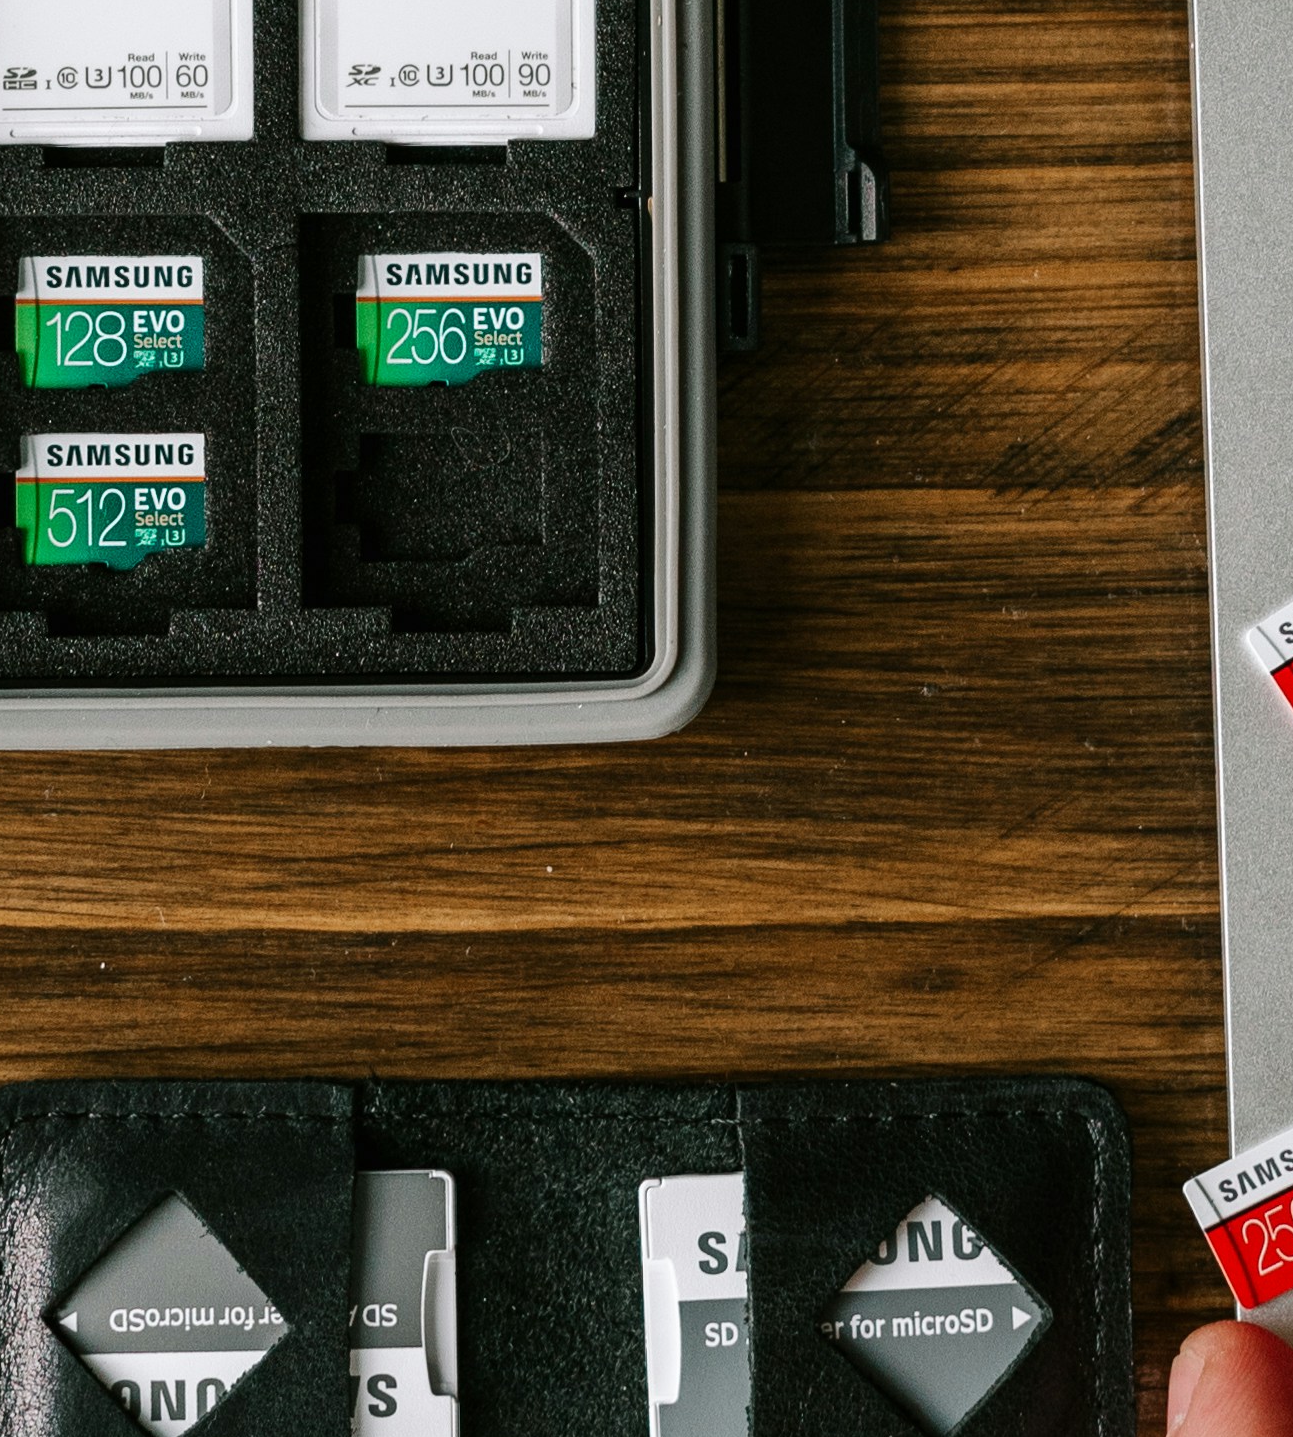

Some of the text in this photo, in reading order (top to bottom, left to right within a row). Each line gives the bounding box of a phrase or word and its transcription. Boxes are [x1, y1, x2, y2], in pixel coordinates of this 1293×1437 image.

[127, 52, 207, 63] Read Write
[470, 51, 549, 61] Read Write
[117, 64, 209, 89] 100 60
[459, 62, 551, 87] 100 90
[46, 265, 193, 289] SAMSUNG
[385, 262, 533, 287] SAMSUNG
[46, 309, 186, 368] 128 EVO
[133, 333, 183, 349] Select
[386, 306, 525, 365] 256 EVO
[473, 330, 523, 346] Select
[46, 443, 194, 468] SAMSUNG
[47, 486, 187, 548] 512 EVO
[134, 510, 185, 527] Select
[109, 1305, 255, 1333] for microSD
[849, 1308, 994, 1340] for microSD
